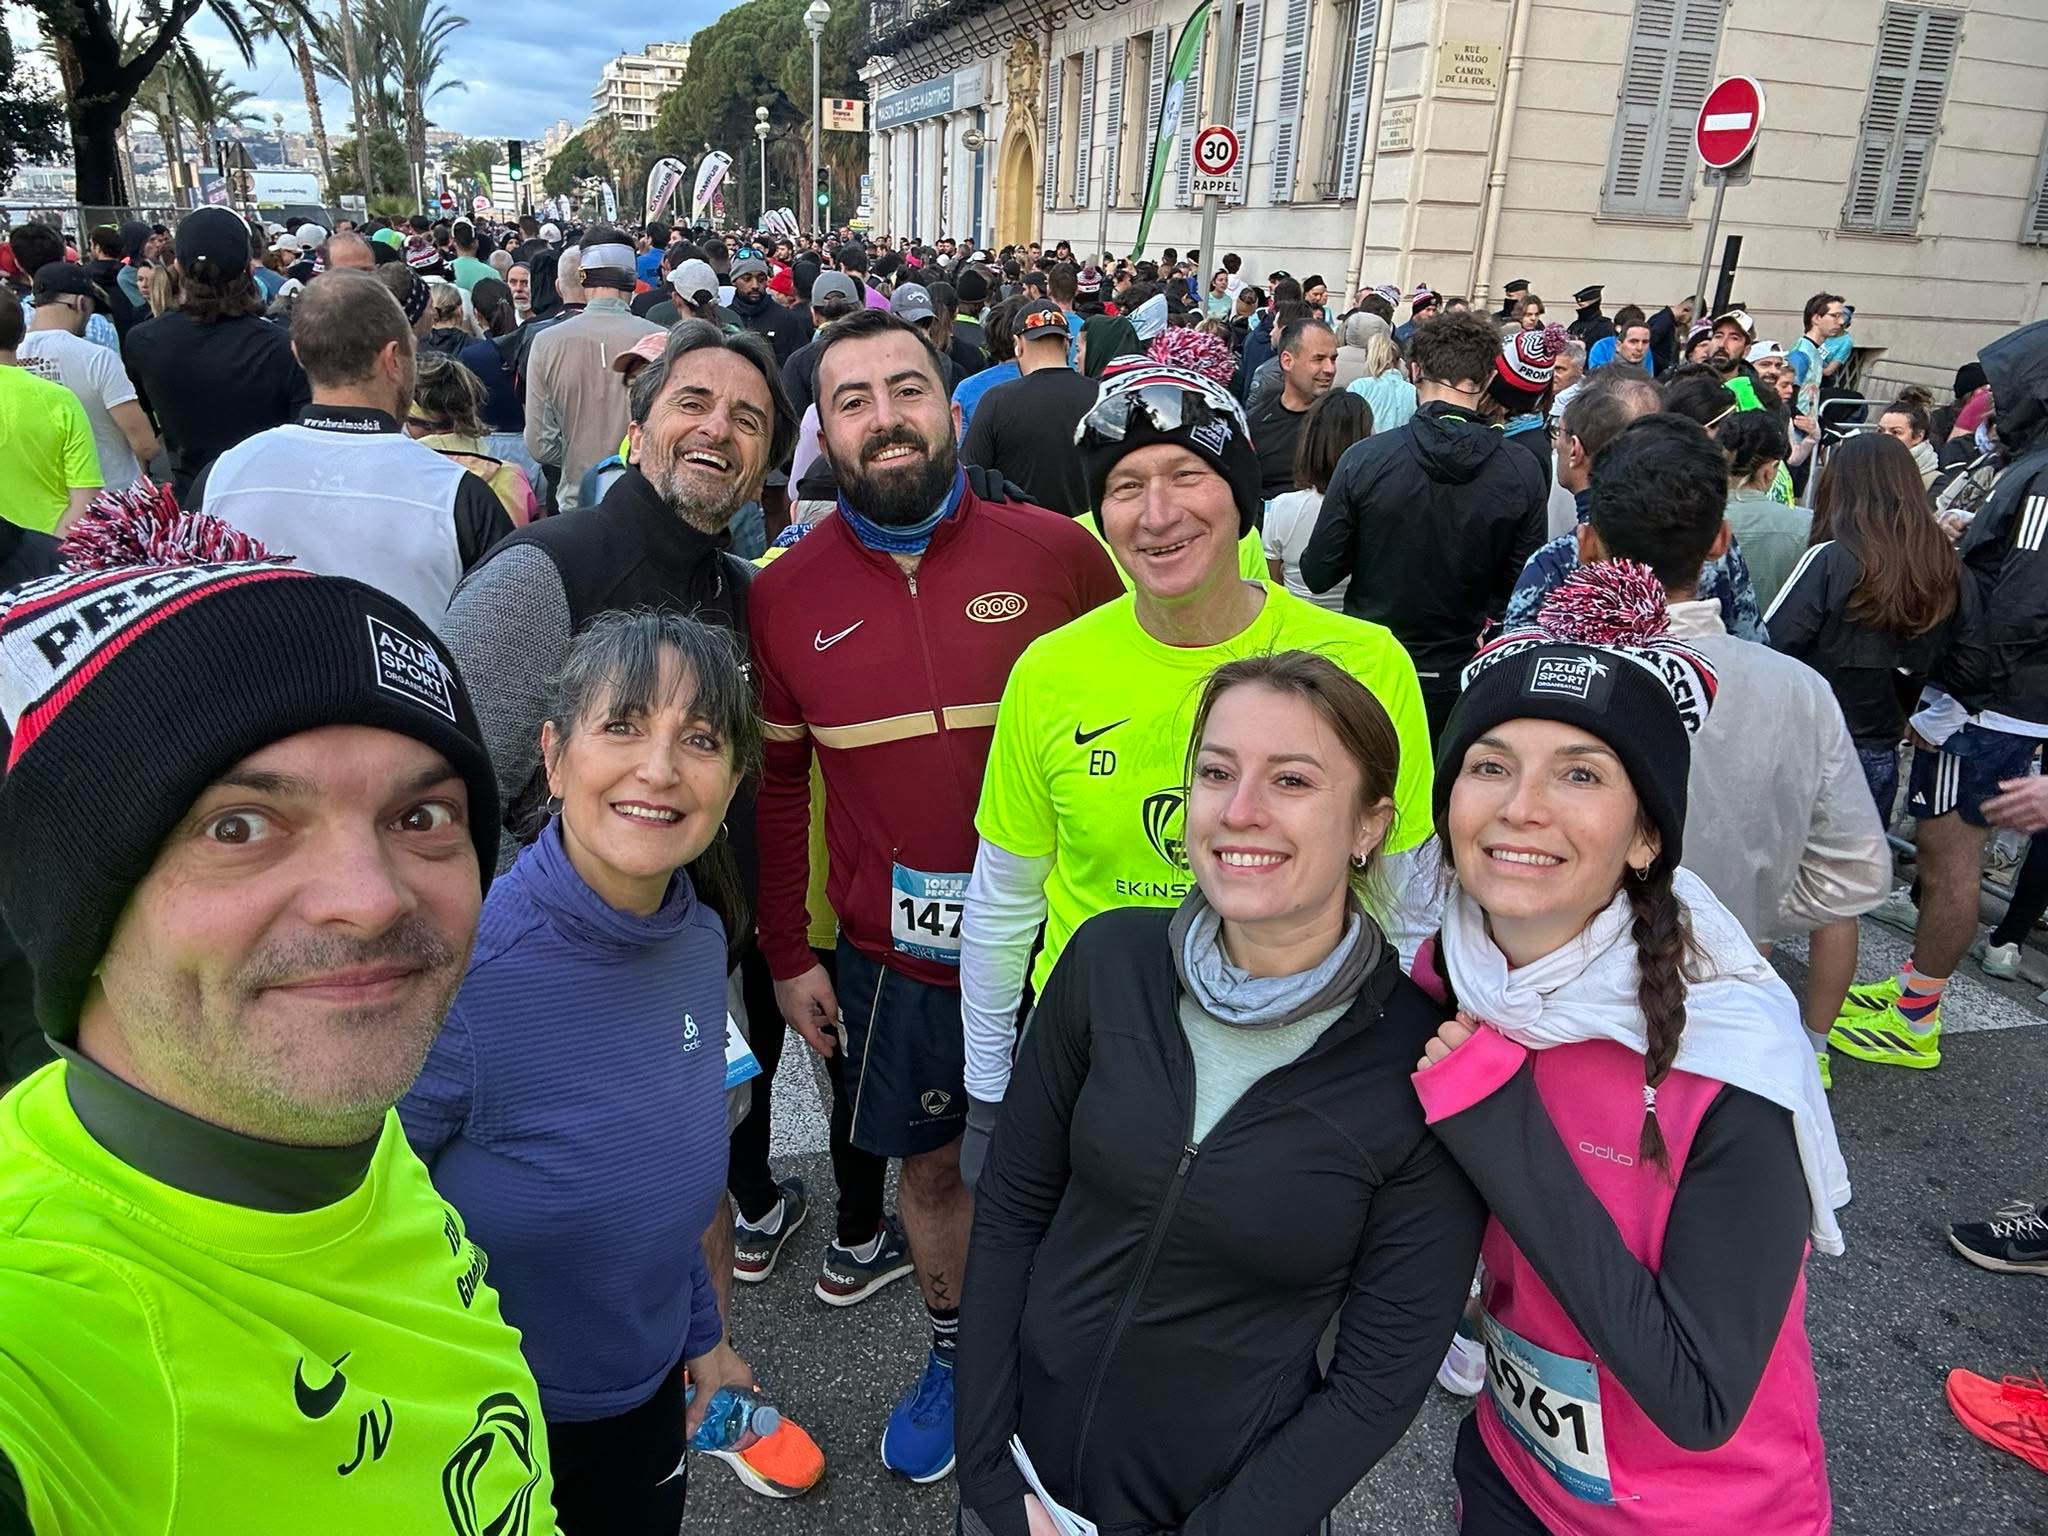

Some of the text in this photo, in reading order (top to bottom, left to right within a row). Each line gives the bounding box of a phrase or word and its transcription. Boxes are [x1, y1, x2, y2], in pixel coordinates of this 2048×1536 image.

[1464, 45, 1480, 54] RUE
[1454, 54, 1488, 64] VANLOO
[1455, 66, 1484, 75] CAMIN
[1445, 75, 1491, 86] DE LA FOUS
[895, 101, 904, 118] DES
[1204, 141, 1229, 160] 30
[697, 164, 720, 201] CAMPUS
[1193, 180, 1239, 192] RAPPEL
[650, 172, 673, 212] CAMPUS
[975, 598, 1019, 615] ROG
[379, 632, 438, 677] AZUR
[381, 651, 443, 694] SPORT
[1541, 662, 1587, 676] AZUR
[1537, 681, 1583, 691] ORGANISATION
[1539, 672, 1586, 685] SPORT
[384, 670, 447, 707] ORGANISATION
[1089, 750, 1117, 776] ED
[899, 898, 964, 938] 147
[1579, 1141, 1633, 1166] odlo
